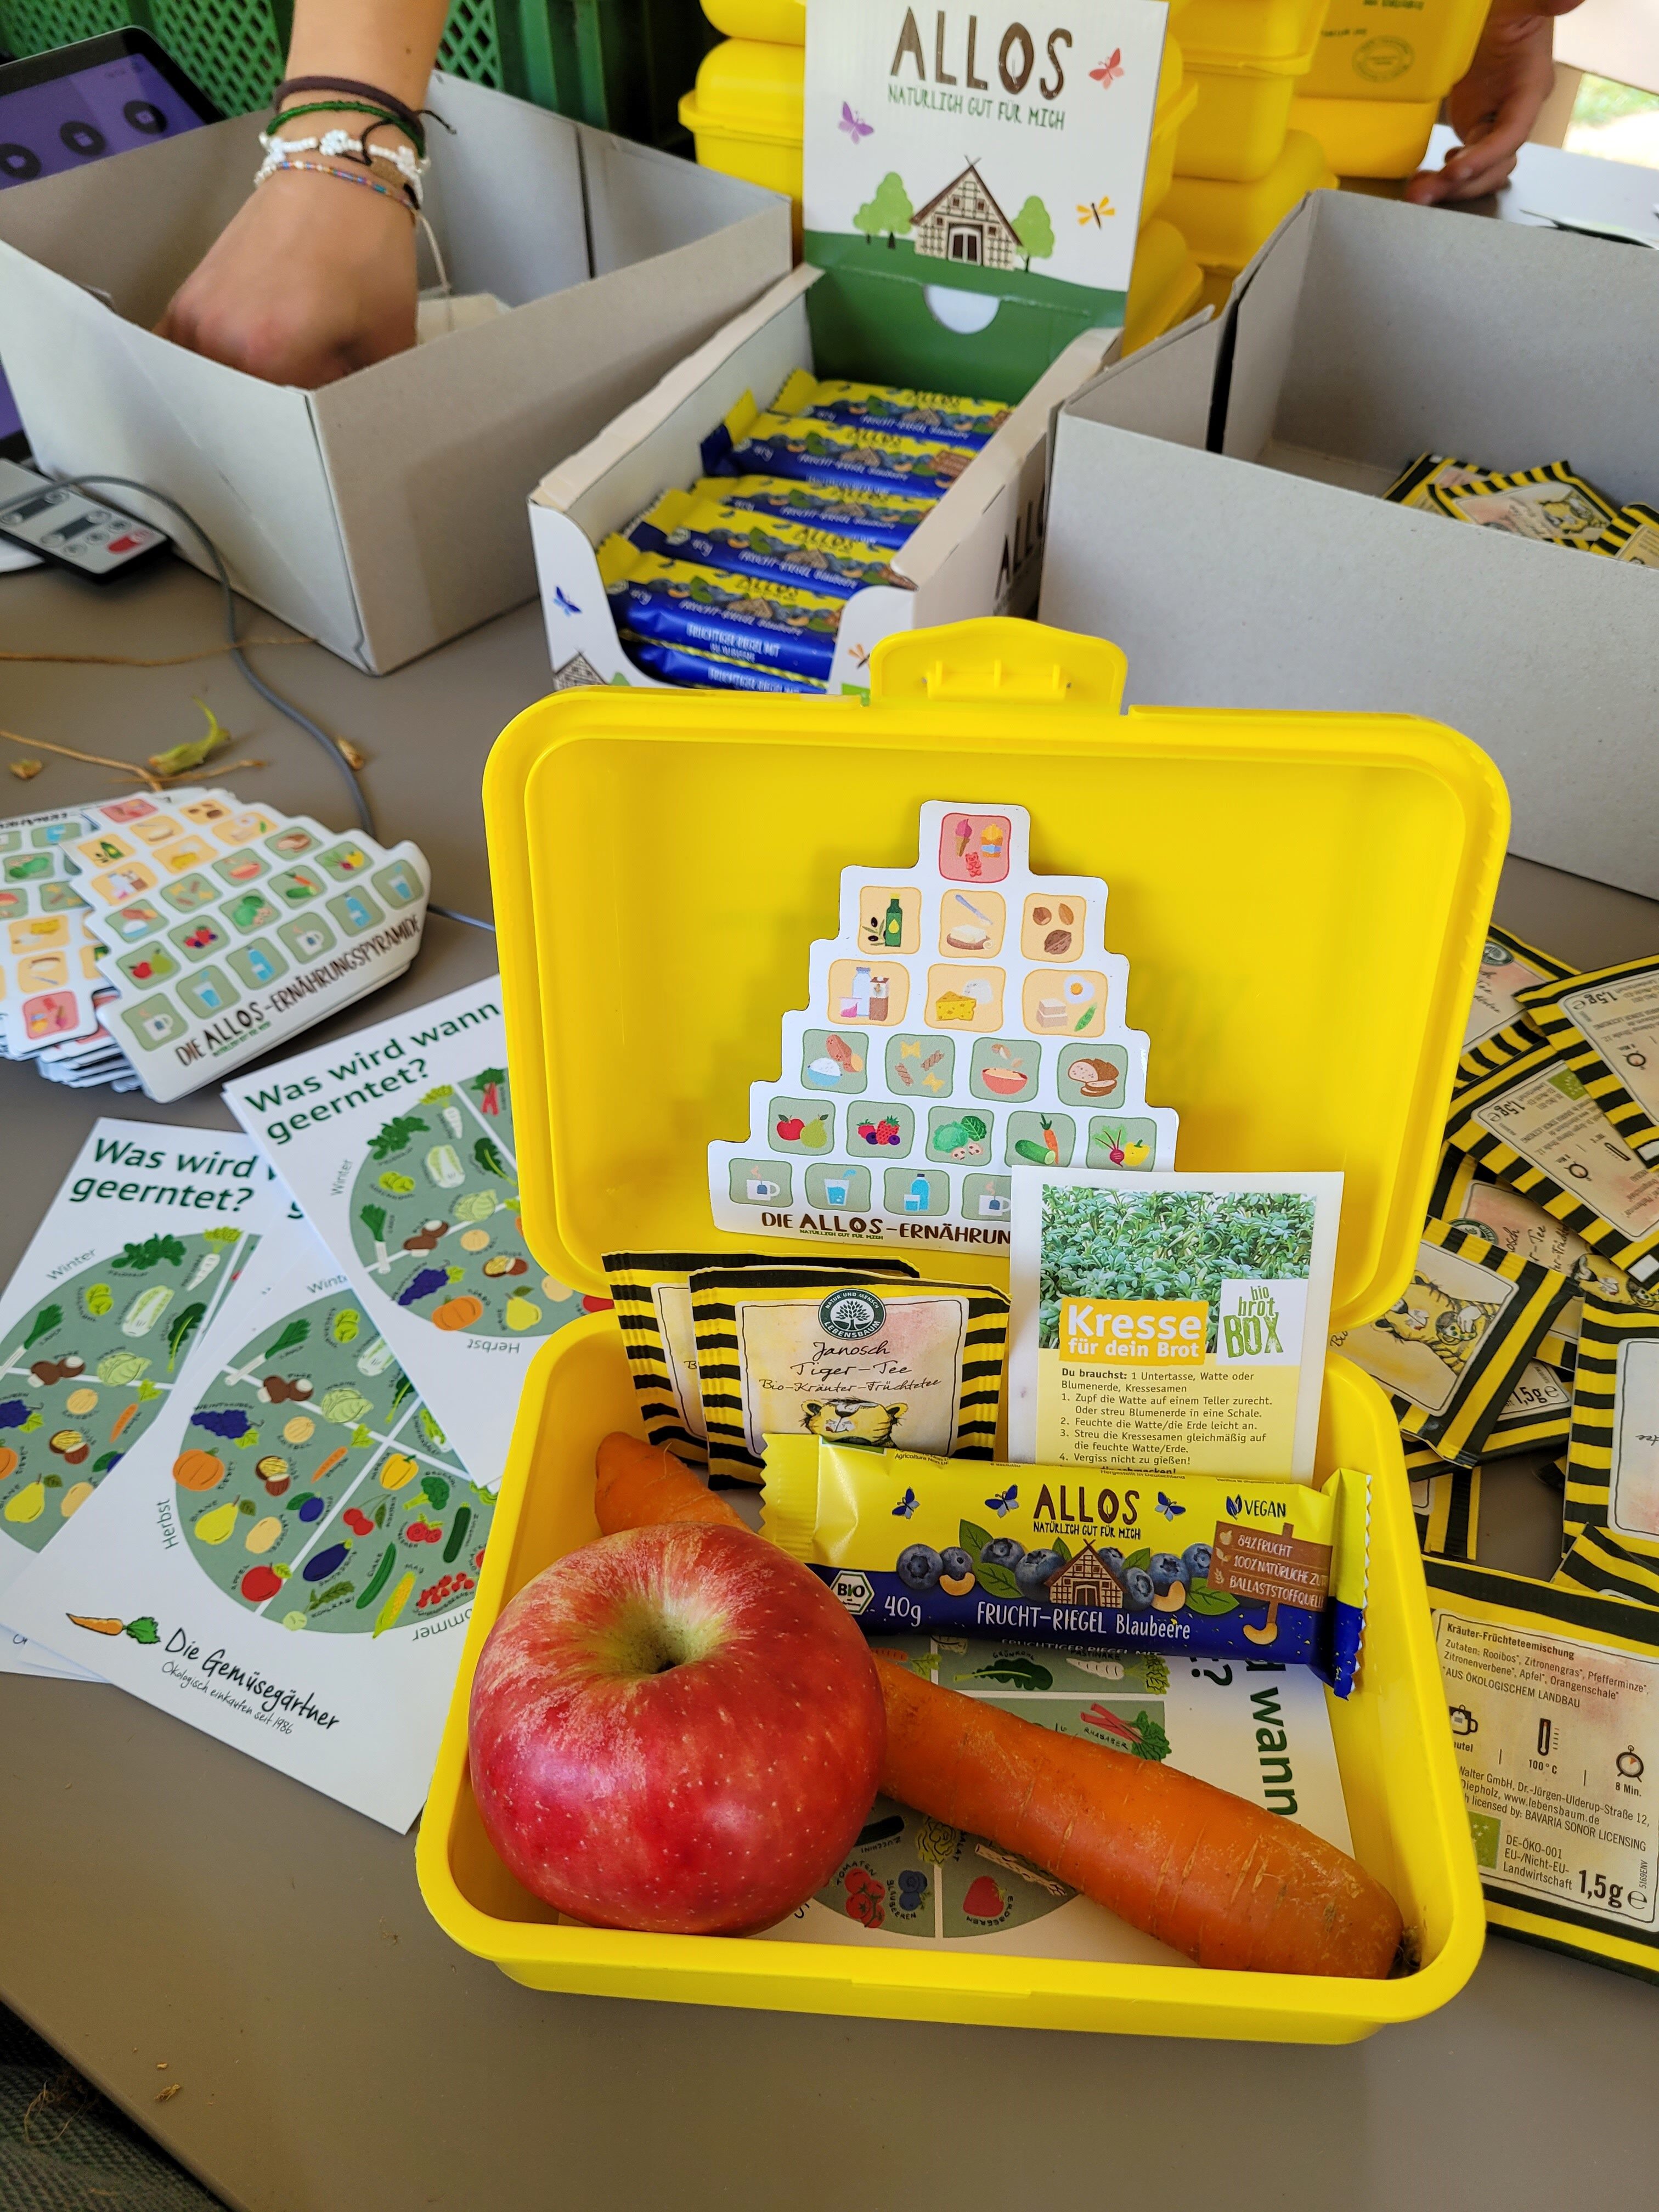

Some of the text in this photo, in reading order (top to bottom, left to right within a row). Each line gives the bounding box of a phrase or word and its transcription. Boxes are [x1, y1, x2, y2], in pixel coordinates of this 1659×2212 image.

[890, 6, 1072, 100] ALLOS
[888, 83, 1065, 131] NATÜRLICH GUT FÜR MICH
[175, 1042, 206, 1066] DIE
[244, 1002, 500, 1114] Was wird wann
[267, 1058, 430, 1145] geerntet?
[94, 1137, 258, 1179] Was wird
[330, 1159, 353, 1197] Winter
[70, 1177, 254, 1212] geerntet?
[761, 1212, 793, 1228] DIE
[1504, 1227, 1520, 1252] osch
[1527, 1224, 1547, 1262] r-Tee
[47, 1248, 97, 1281] Winter
[825, 1295, 842, 1309] NATUR
[858, 1293, 879, 1309] MENSCH
[1250, 1285, 1270, 1301] bio
[1238, 1297, 1276, 1317] brot
[824, 1321, 881, 1338] LEBENSBAUM
[1068, 1305, 1202, 1340] Kresse
[1223, 1312, 1284, 1358] BOX
[467, 1338, 520, 1354] Herbst
[812, 1340, 891, 1362] Janosch
[1068, 1338, 1199, 1358] für dein Brot
[791, 1359, 912, 1382] Tiger-Tee
[1062, 1368, 1075, 1377] Du
[1079, 1368, 1127, 1380] brauchst:
[1131, 1372, 1136, 1380] 1
[1141, 1372, 1195, 1381] Untertasse,
[1200, 1372, 1228, 1381] Watte
[759, 1378, 942, 1393] Bio-Kräuter-Früchtetee
[1062, 1381, 1187, 1393] Blumenerde, Kressesamen
[1513, 1386, 1547, 1404] 1,5g
[1062, 1393, 1273, 1405] 1. Zupf die Watte auf einem Teller zurecht.
[1075, 1405, 1262, 1418] Oder streu Blumenerde in eine Schale.
[1060, 1417, 1257, 1430] 2. Feuchte die Watte/die Erde leicht an.
[1060, 1429, 1267, 1443] 3. Streu die Kressesamen gleichmäßig auf
[1059, 1453, 1069, 1462] 4.
[1074, 1453, 1107, 1464] Vergiss
[1110, 1454, 1136, 1464] nicht
[1153, 1455, 1190, 1466] gießen!
[1074, 1441, 1189, 1454] die feuchte Watte/Erde.
[1033, 1483, 1139, 1525] ALLOS
[1244, 1500, 1286, 1518] VEGAN
[157, 1497, 180, 1550] Herbst
[1033, 1520, 1141, 1540] NATÜRLICH GUT FÜR MICH
[1238, 1534, 1294, 1558] 84% FRUCHT
[1234, 1555, 1310, 1583] 100% NATÜRLICHE
[837, 1583, 865, 1598] BIO
[412, 1607, 472, 1641] ommer
[884, 1595, 921, 1627] 40g
[977, 1601, 1190, 1640] FRUCHT-RIEGEL Blaubeere
[1445, 1639, 1481, 1656] Zutaten:
[1447, 1622, 1575, 1661] Kräuter-Früchteteemischung
[992, 1650, 1035, 1661] GRÜNKOHL
[165, 1627, 340, 1730] Die Gemüsegärtner
[1465, 1672, 1535, 1697] ÖKOLOGISCHEM
[1538, 1690, 1580, 1708] LANDBAU
[210, 1686, 253, 1714] einkaufen
[254, 1711, 273, 1725] seit
[273, 1716, 293, 1735] 1986
[1249, 1686, 1298, 1815] wann
[1487, 1774, 1515, 1791] GmbH,
[1517, 1782, 1633, 1821] Dr.-Jürgen-Ulderup-Straße
[1637, 1813, 1650, 1827] 12,
[1624, 1784, 1642, 1797] Min.
[1504, 1792, 1600, 1825] www.lebensbaum.de
[1472, 1796, 1508, 1813] licensed
[1510, 1805, 1522, 1818] by:
[1525, 1810, 1562, 1829] BAVARIA
[1565, 1820, 1595, 1837] SONOR
[1599, 1829, 1646, 1852] LICENSING
[861, 1836, 901, 1854] ZUCCHINI
[1506, 1834, 1562, 1860] DE-ÖKO-001
[837, 1860, 877, 1886] TOMATEN
[1504, 1848, 1570, 1875] EU-/Nicht-EU-
[1639, 1859, 1649, 1889] 5169ENV
[1503, 1861, 1572, 1890] Landwirtschaft
[886, 1879, 917, 1920] BLAUBEEREN
[1578, 1869, 1623, 1909] 1,5g
[965, 1895, 1014, 1927] ERDBEEREN
